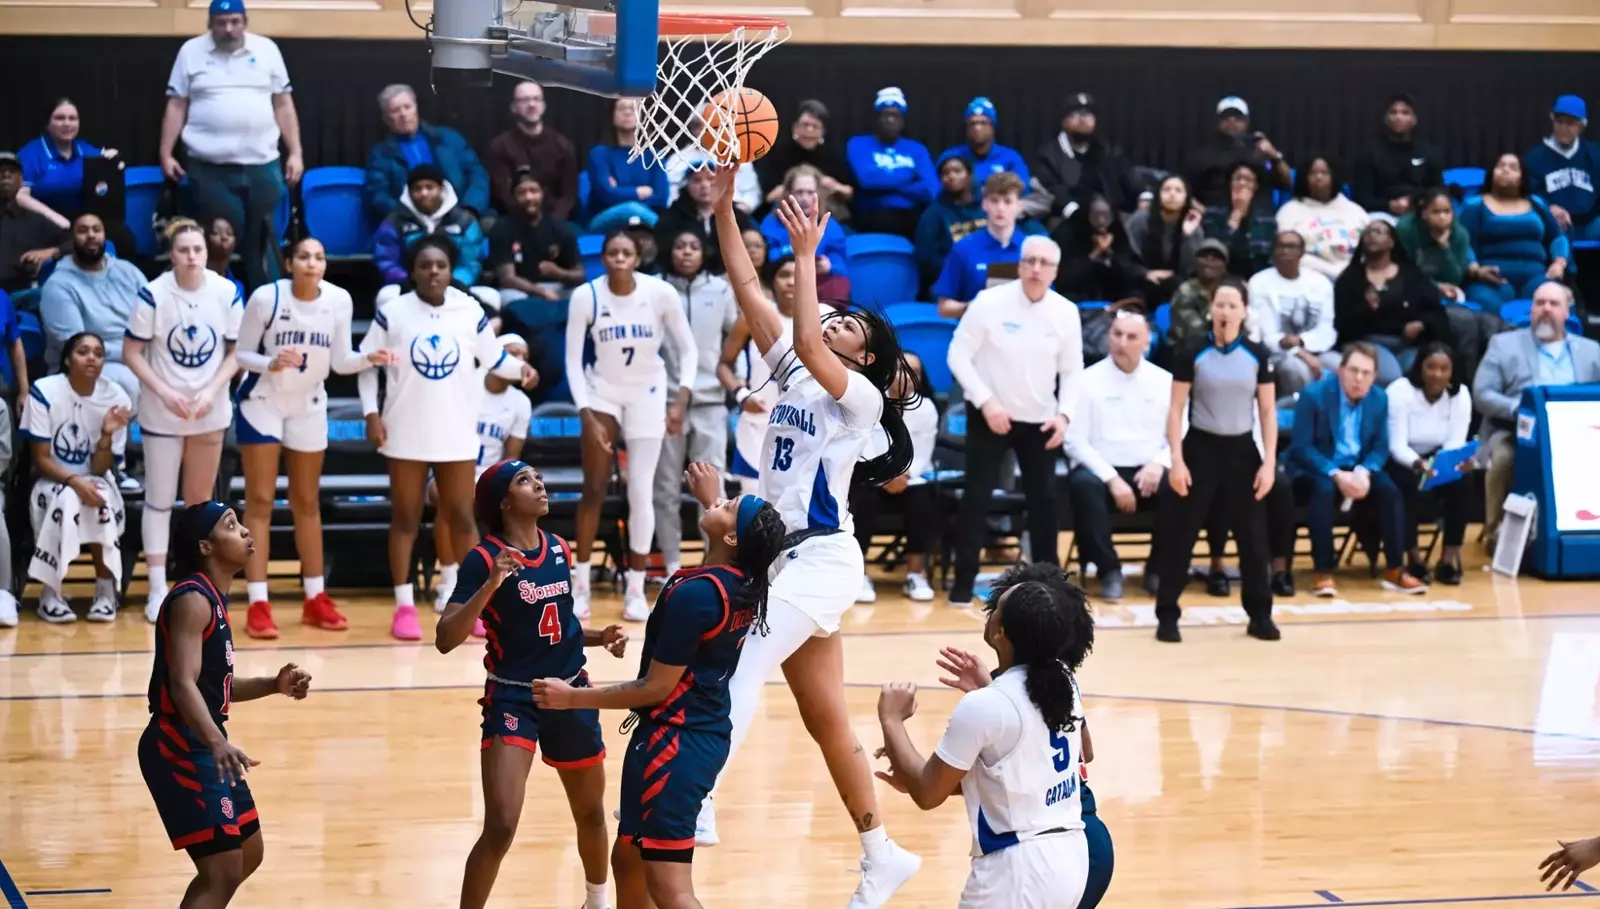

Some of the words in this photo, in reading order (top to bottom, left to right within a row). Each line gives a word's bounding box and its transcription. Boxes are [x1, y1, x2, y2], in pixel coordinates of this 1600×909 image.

[621, 345, 635, 367] 7
[771, 435, 795, 472] 13
[538, 602, 562, 645] 4
[1049, 729, 1071, 773] 5
